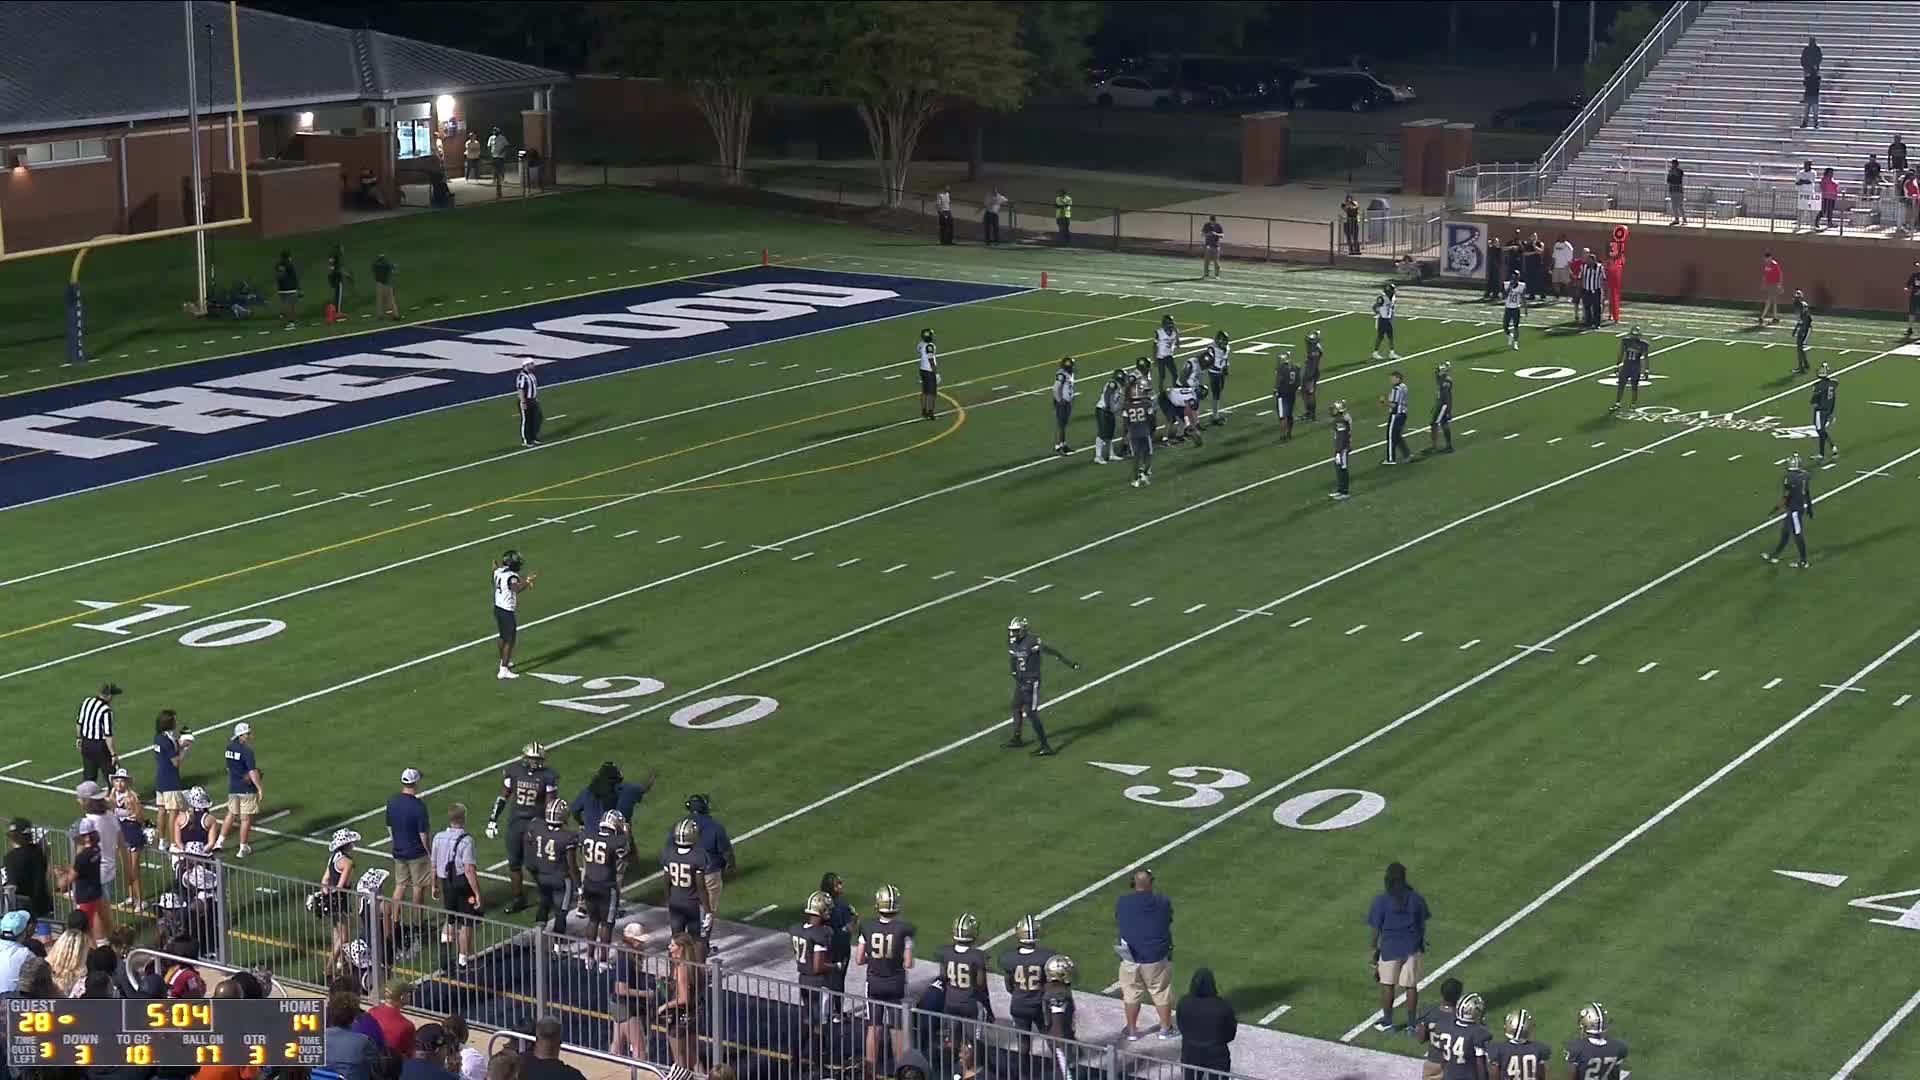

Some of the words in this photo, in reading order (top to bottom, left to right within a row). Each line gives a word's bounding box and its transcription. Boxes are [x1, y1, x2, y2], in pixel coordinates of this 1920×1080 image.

[1127, 407, 1145, 422] 22
[516, 787, 538, 806] 52
[535, 835, 556, 861] 14
[583, 838, 607, 864] 36
[669, 862, 692, 888] 95
[871, 932, 894, 960] 91
[946, 960, 970, 988] 46
[1014, 964, 1041, 991] 42
[1440, 1032, 1465, 1064] 34
[1506, 1054, 1537, 1080] 40
[1584, 1056, 1618, 1080] 27
